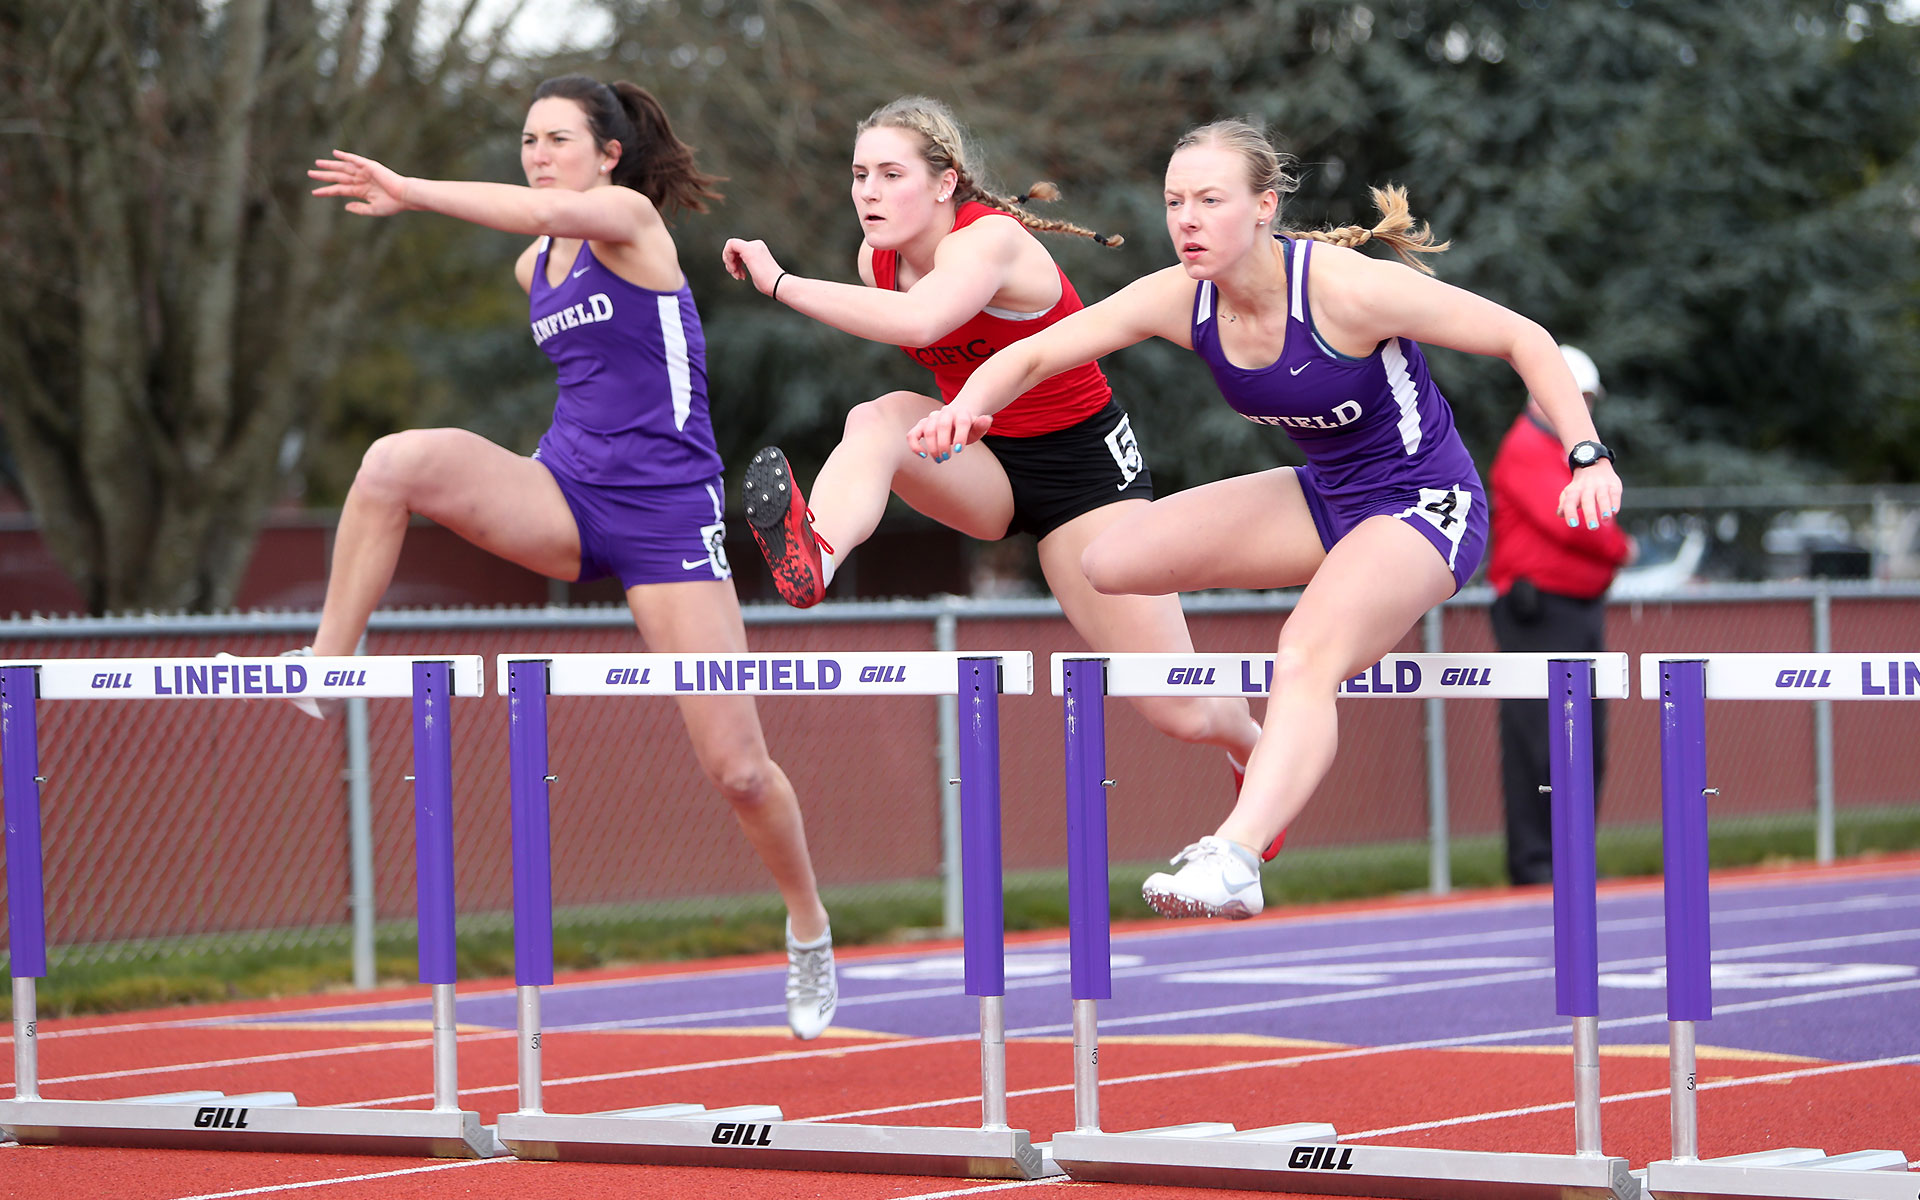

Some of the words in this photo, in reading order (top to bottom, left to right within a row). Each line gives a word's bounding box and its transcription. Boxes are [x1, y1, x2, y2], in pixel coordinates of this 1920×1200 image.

[532, 292, 614, 347] INFIELD
[903, 338, 996, 367] CIFIC
[1115, 423, 1139, 473] 5
[1424, 491, 1458, 530] 4
[92, 674, 131, 688] GILL
[155, 665, 307, 694] LINFIELD
[324, 671, 365, 686] GILL
[606, 669, 650, 684] GILL
[675, 660, 841, 691] LINFIELD
[859, 666, 905, 682] GILL
[1167, 668, 1215, 684] GILL
[1241, 660, 1422, 693] LIELD
[1441, 668, 1491, 685] GILL
[1776, 670, 1830, 687] GILL
[194, 1107, 248, 1128] GILL
[711, 1122, 772, 1146] GILL
[1288, 1146, 1354, 1171] GILL
